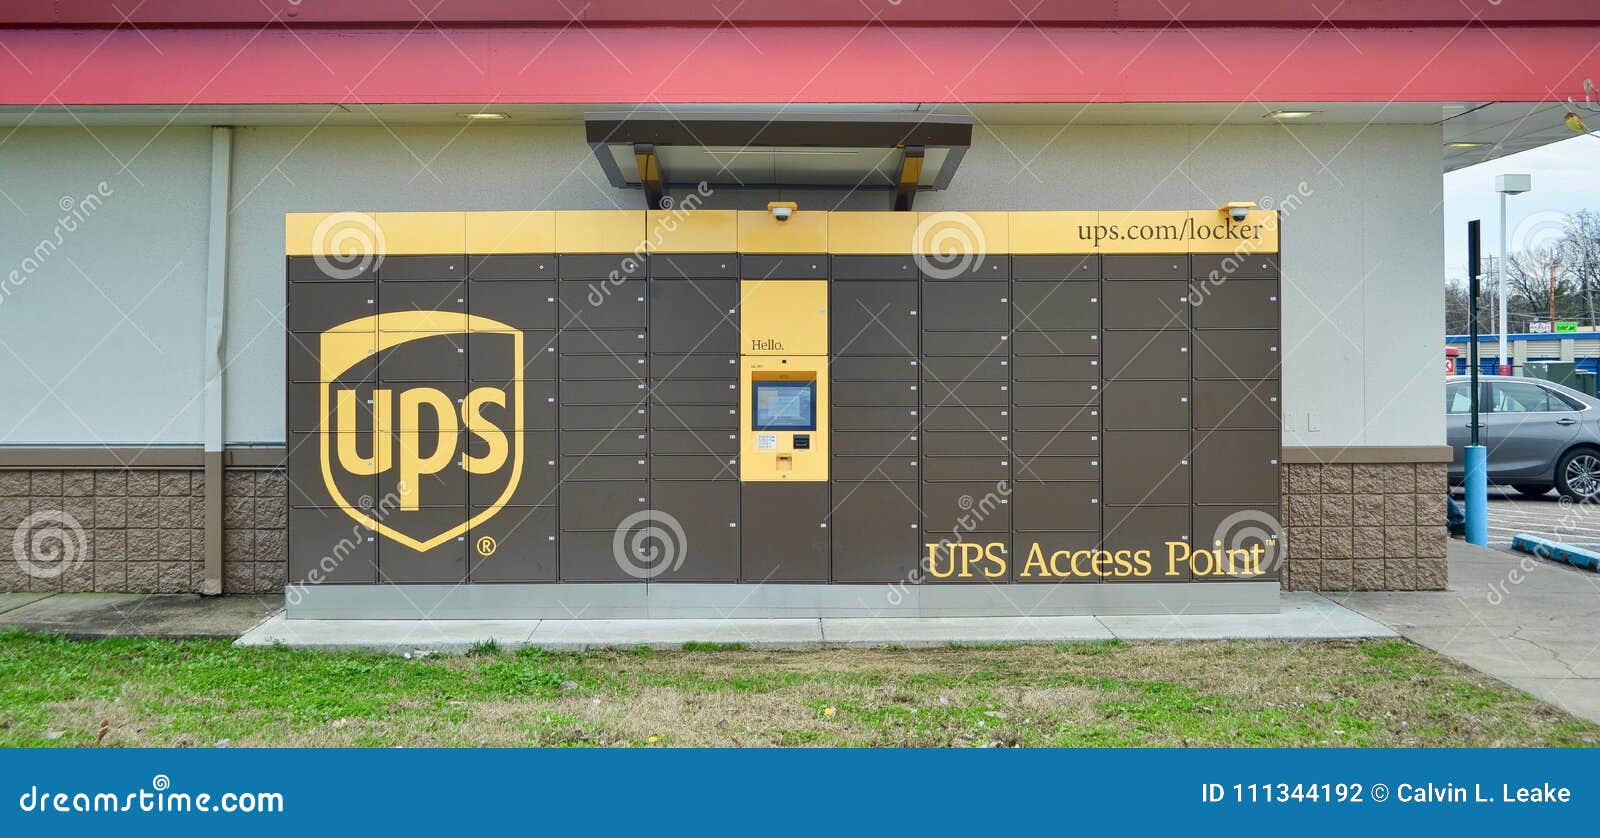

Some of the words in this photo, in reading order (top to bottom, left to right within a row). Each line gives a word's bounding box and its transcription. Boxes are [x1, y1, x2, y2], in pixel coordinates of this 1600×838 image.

[1078, 217, 1263, 247] ups.com/locker
[752, 339, 785, 351] Hello.
[337, 387, 509, 511] ups
[925, 542, 1007, 578] UPS
[1020, 542, 1152, 577] Access
